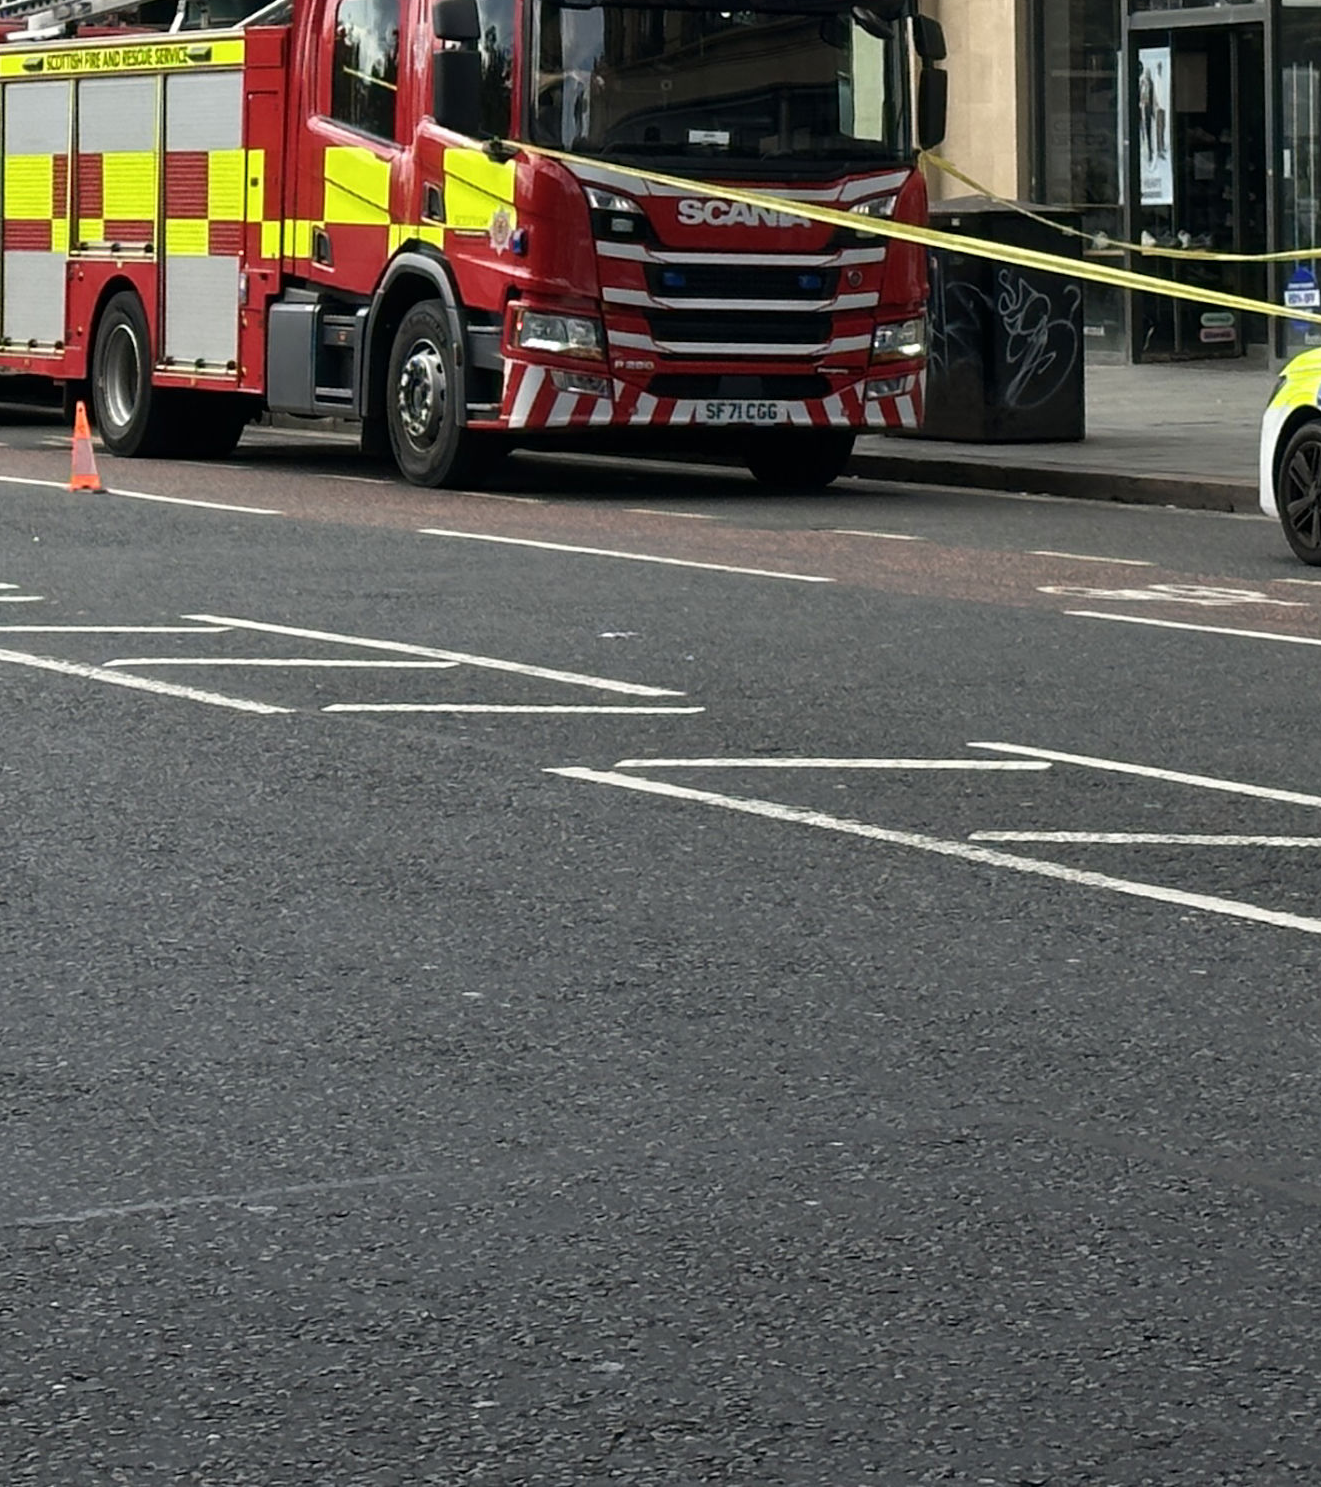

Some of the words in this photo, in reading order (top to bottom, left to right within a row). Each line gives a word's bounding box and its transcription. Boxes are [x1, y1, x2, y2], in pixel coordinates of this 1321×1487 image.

[46, 54, 83, 71] SCOTTISH
[85, 53, 101, 69] FIRE
[102, 52, 120, 68] AND
[122, 49, 152, 66] RESCUE
